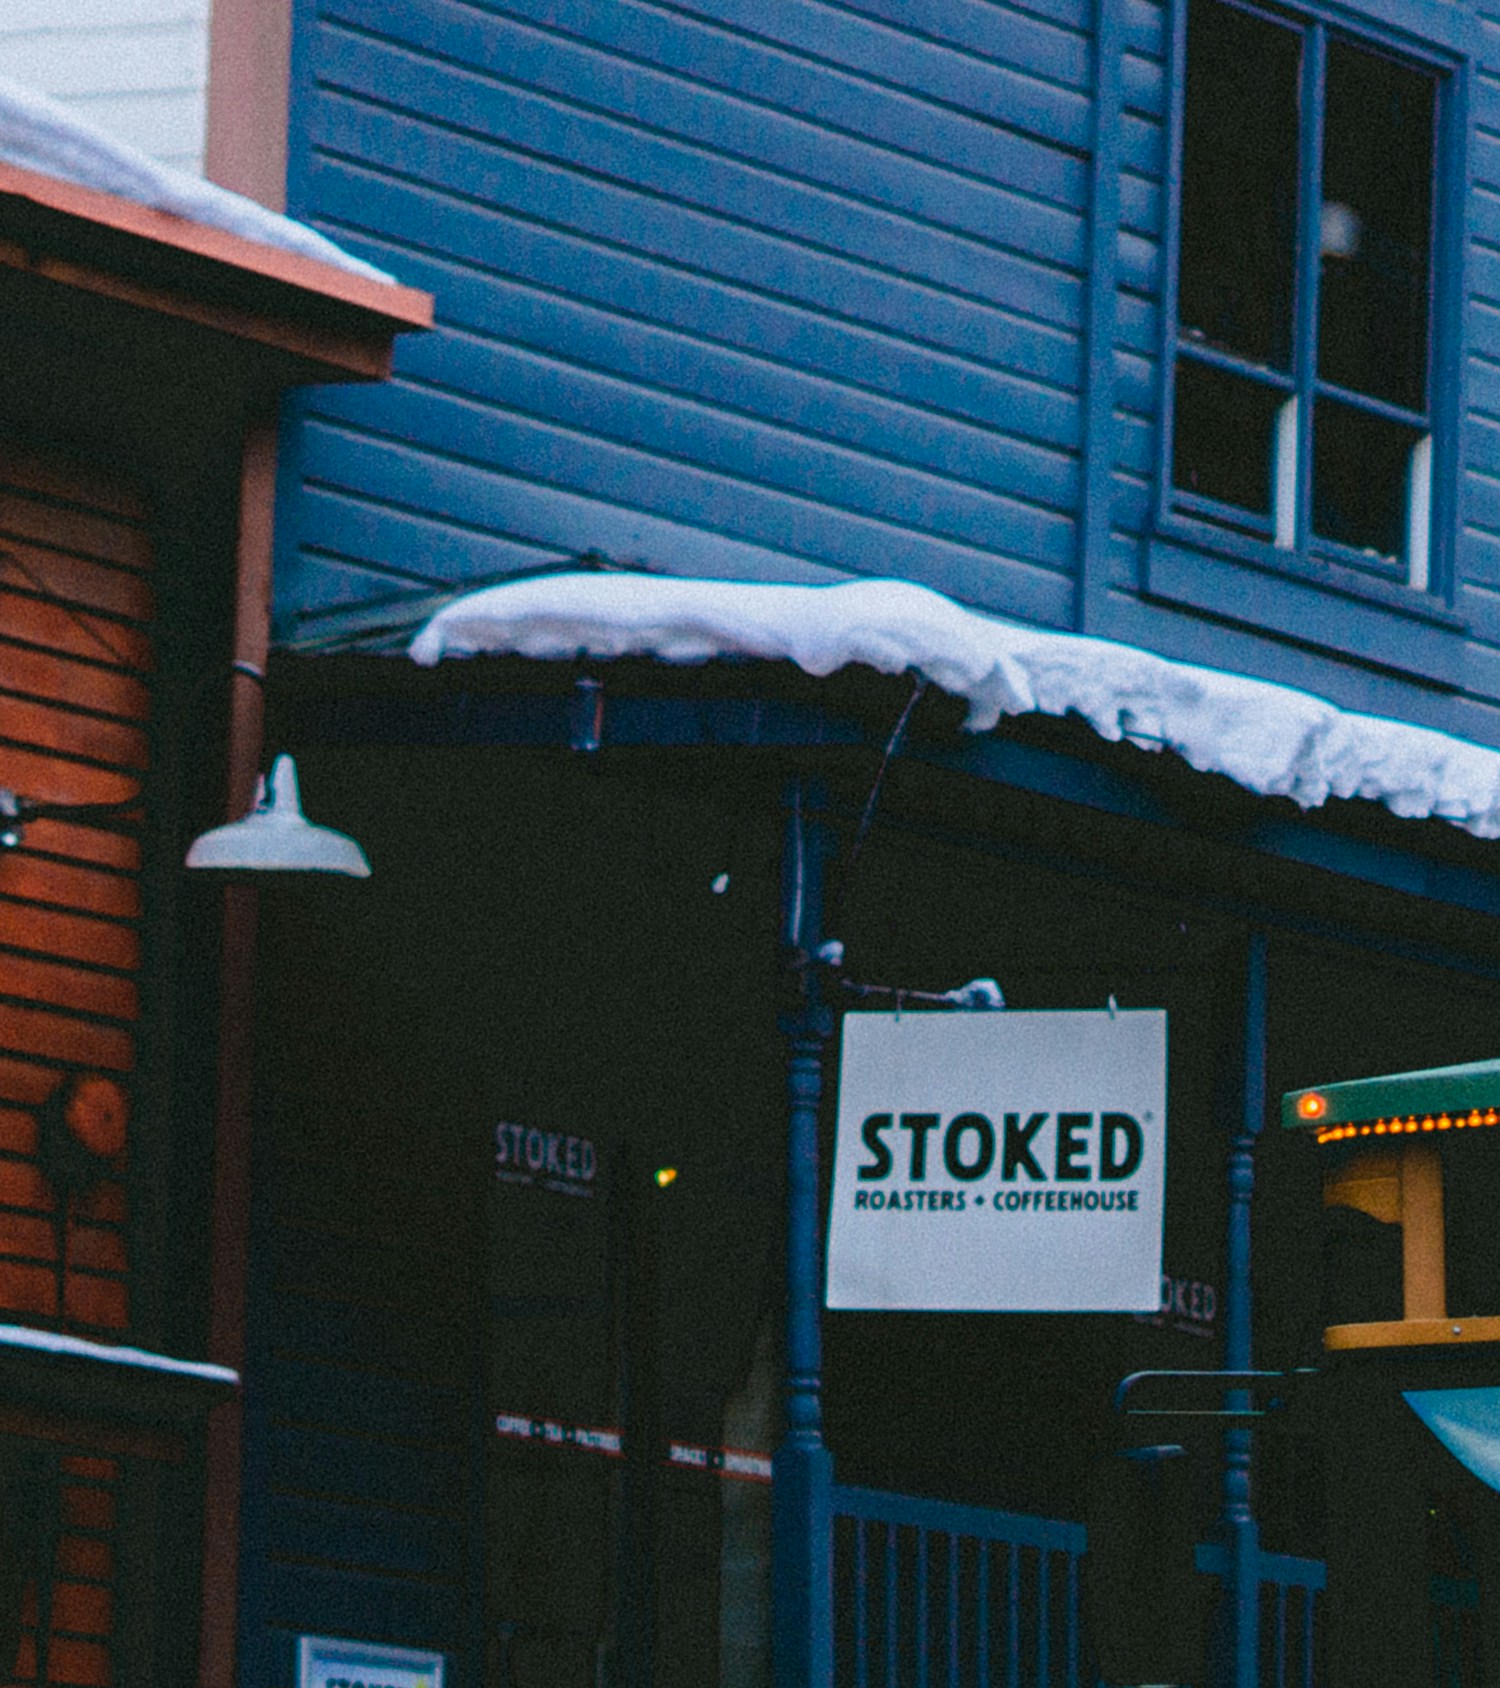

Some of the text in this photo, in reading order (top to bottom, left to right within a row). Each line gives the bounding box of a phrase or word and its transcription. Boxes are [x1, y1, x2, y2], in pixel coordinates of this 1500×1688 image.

[494, 1119, 598, 1182] STOKED
[856, 1111, 1144, 1181] STOKED
[854, 1189, 1139, 1211] ROASTERS COFFEEHOUSE
